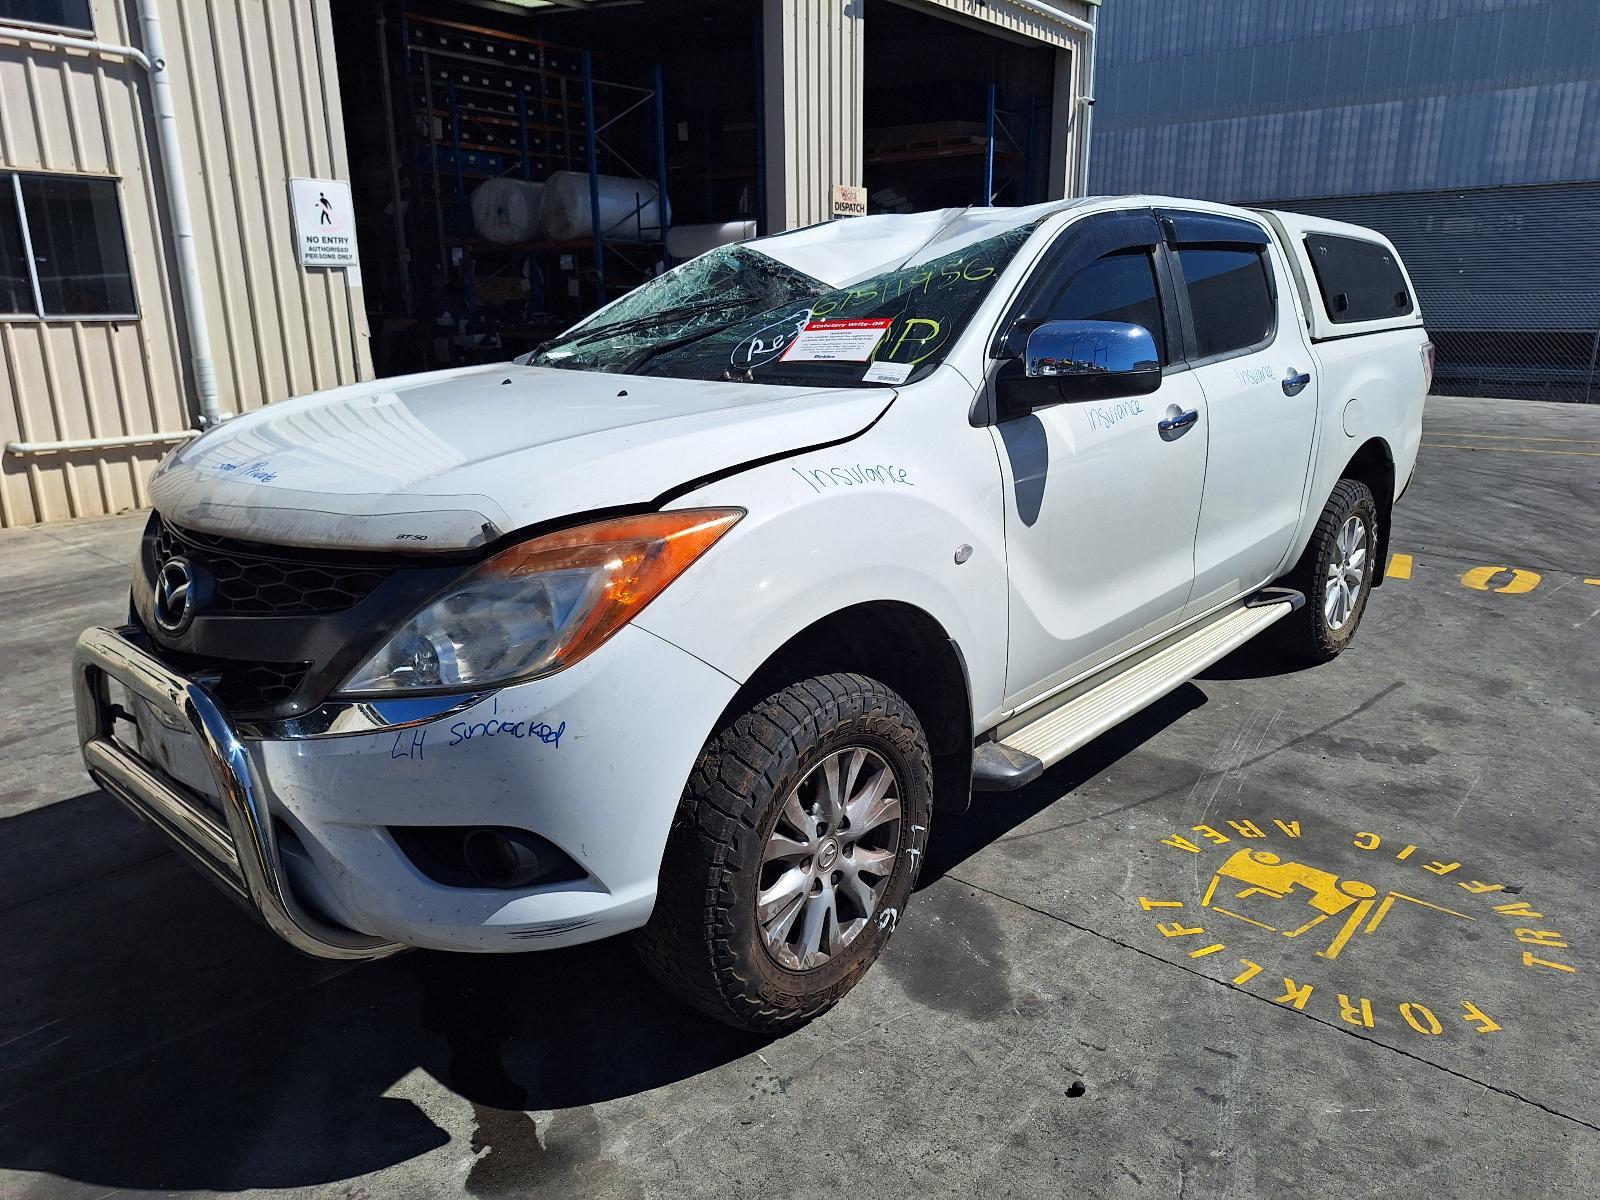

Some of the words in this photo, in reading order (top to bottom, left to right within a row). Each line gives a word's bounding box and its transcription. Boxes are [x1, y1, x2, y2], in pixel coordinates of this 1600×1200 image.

[834, 201, 865, 213] DISPATCH
[321, 236, 349, 244] ENTRY
[792, 464, 914, 493] Insurance
[391, 730, 427, 760] LH
[1160, 818, 1301, 853] AREA
[1353, 831, 1577, 973] TRAFFIC
[1138, 896, 1503, 1035] FORKLIFT
